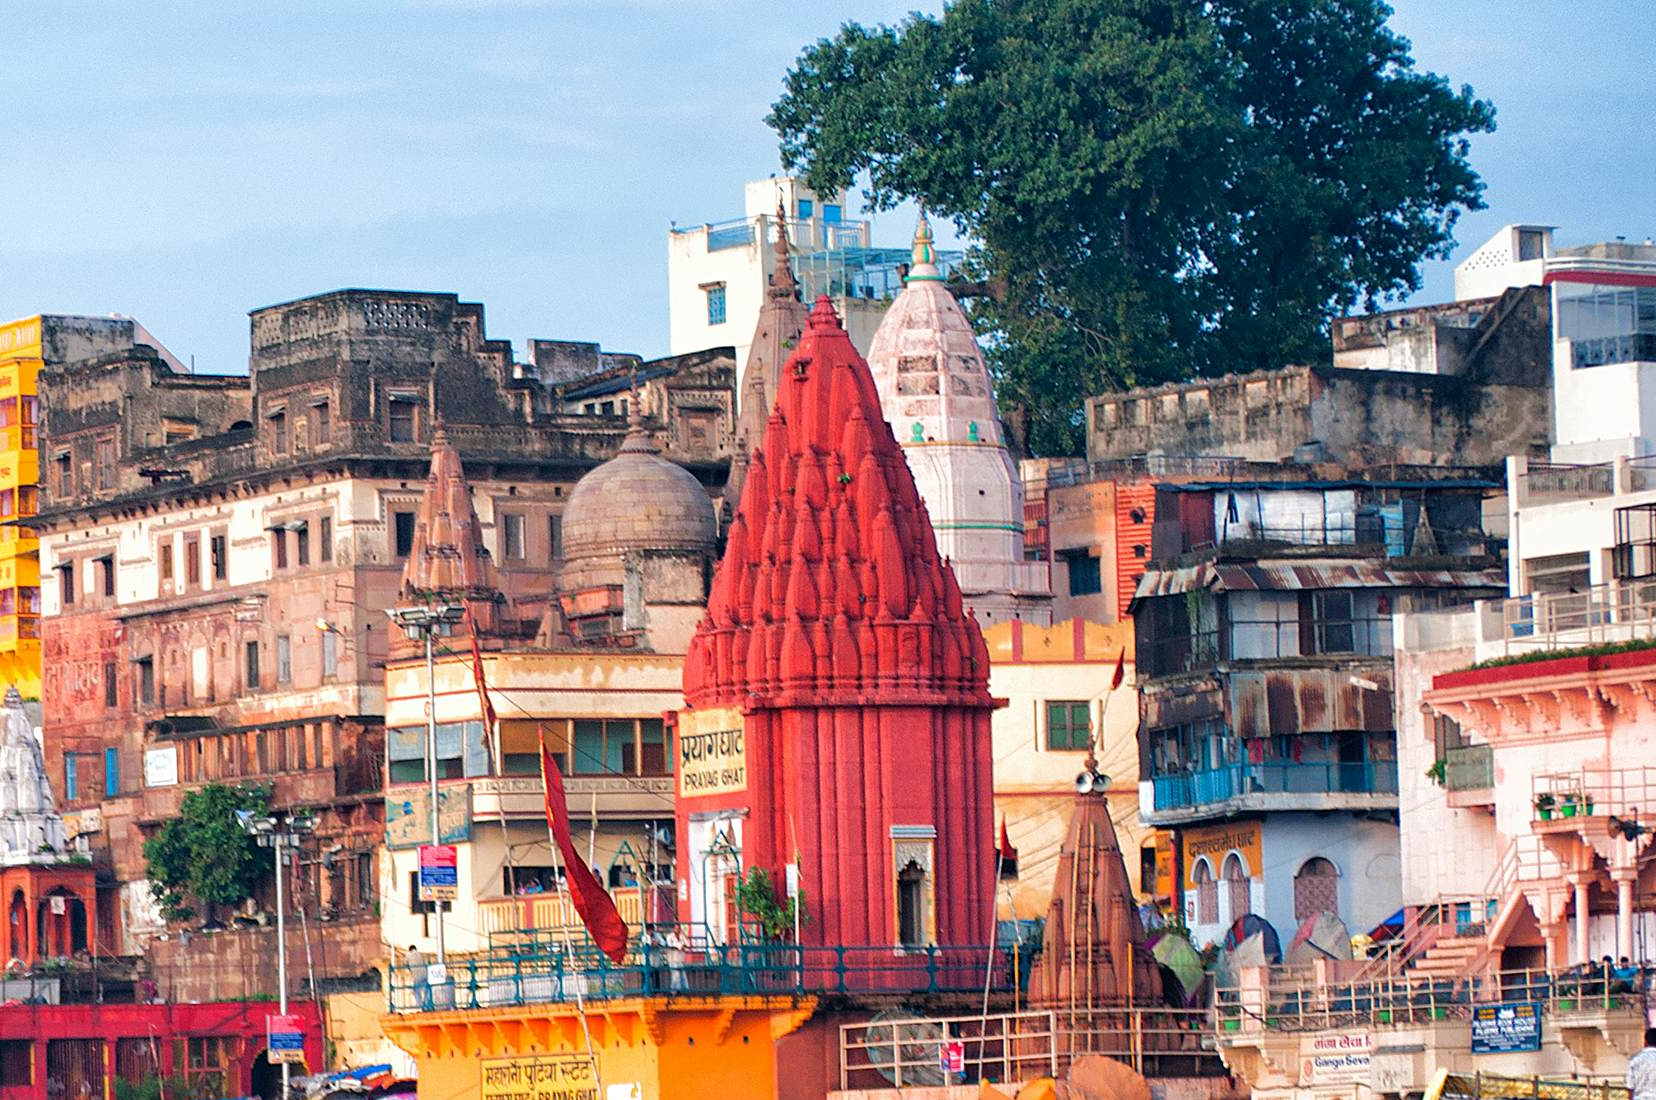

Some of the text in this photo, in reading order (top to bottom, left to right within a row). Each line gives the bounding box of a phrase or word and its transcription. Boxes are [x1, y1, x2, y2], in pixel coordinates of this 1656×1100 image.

[685, 767, 744, 791] PRAYAG GHAT
[1315, 1056, 1344, 1069] Ganga
